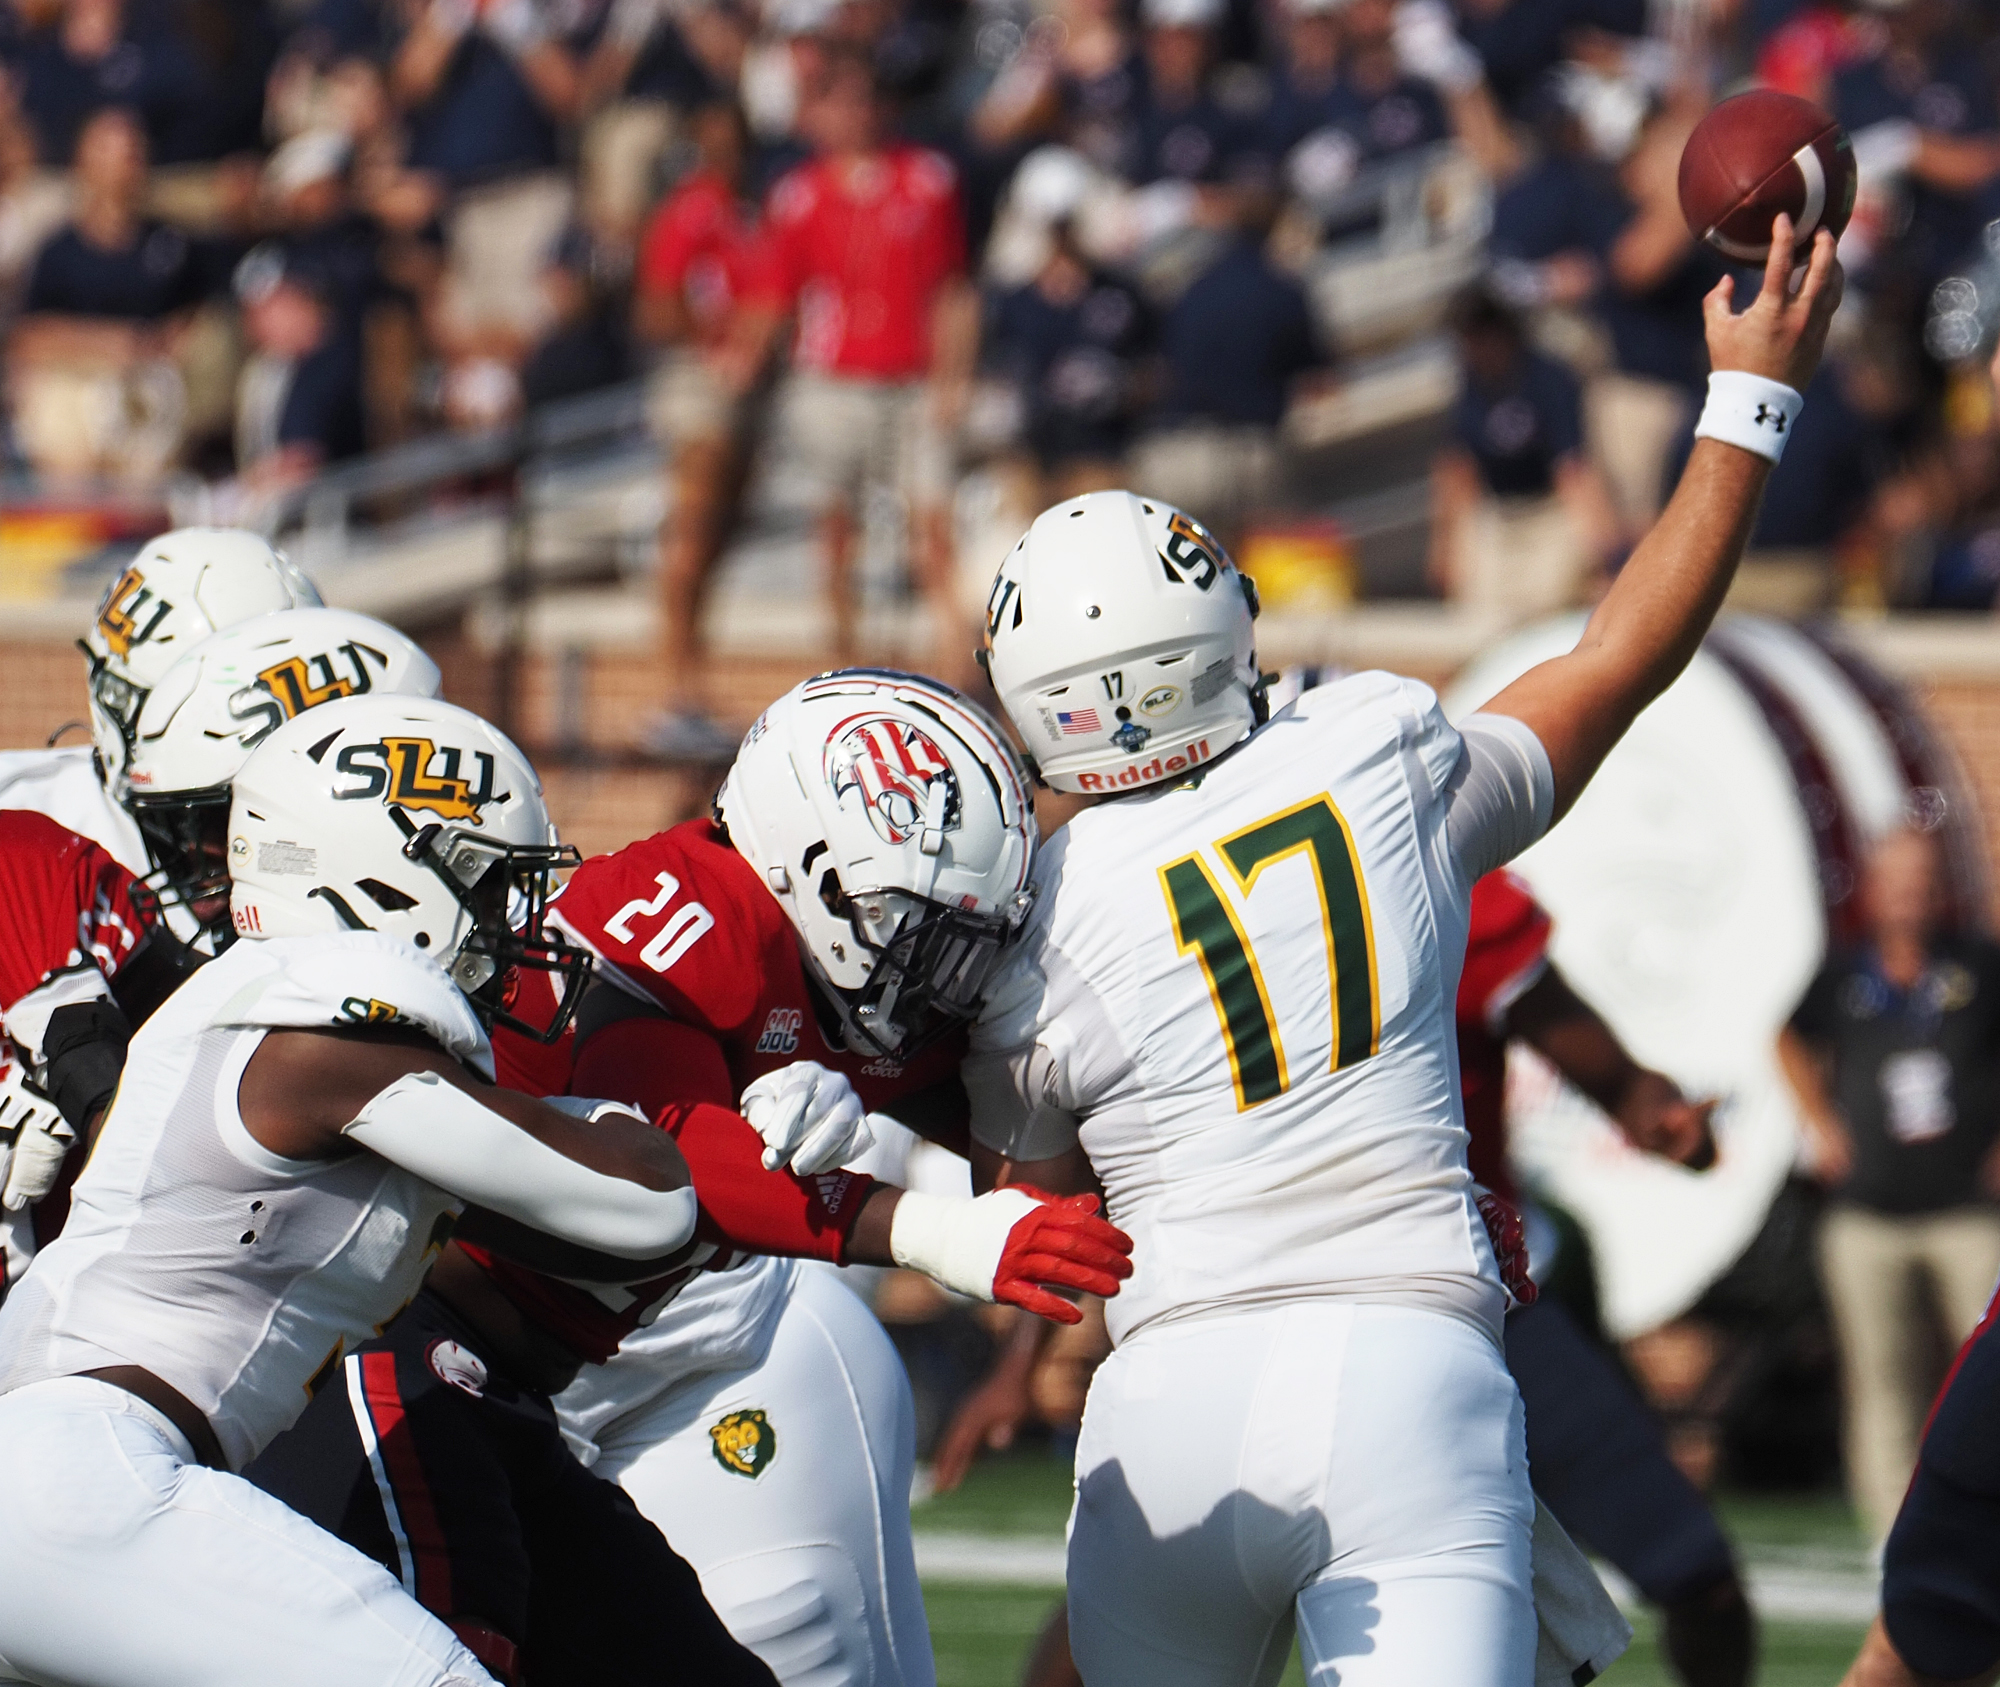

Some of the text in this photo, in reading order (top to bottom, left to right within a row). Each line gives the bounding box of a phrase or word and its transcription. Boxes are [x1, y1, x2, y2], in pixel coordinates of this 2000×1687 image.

[228, 643, 372, 748] SLU
[1099, 670, 1124, 701] 17
[332, 737, 496, 822] SLU
[1077, 739, 1211, 791] Riddell
[603, 870, 715, 973] 20
[1156, 791, 1381, 1113] 17
